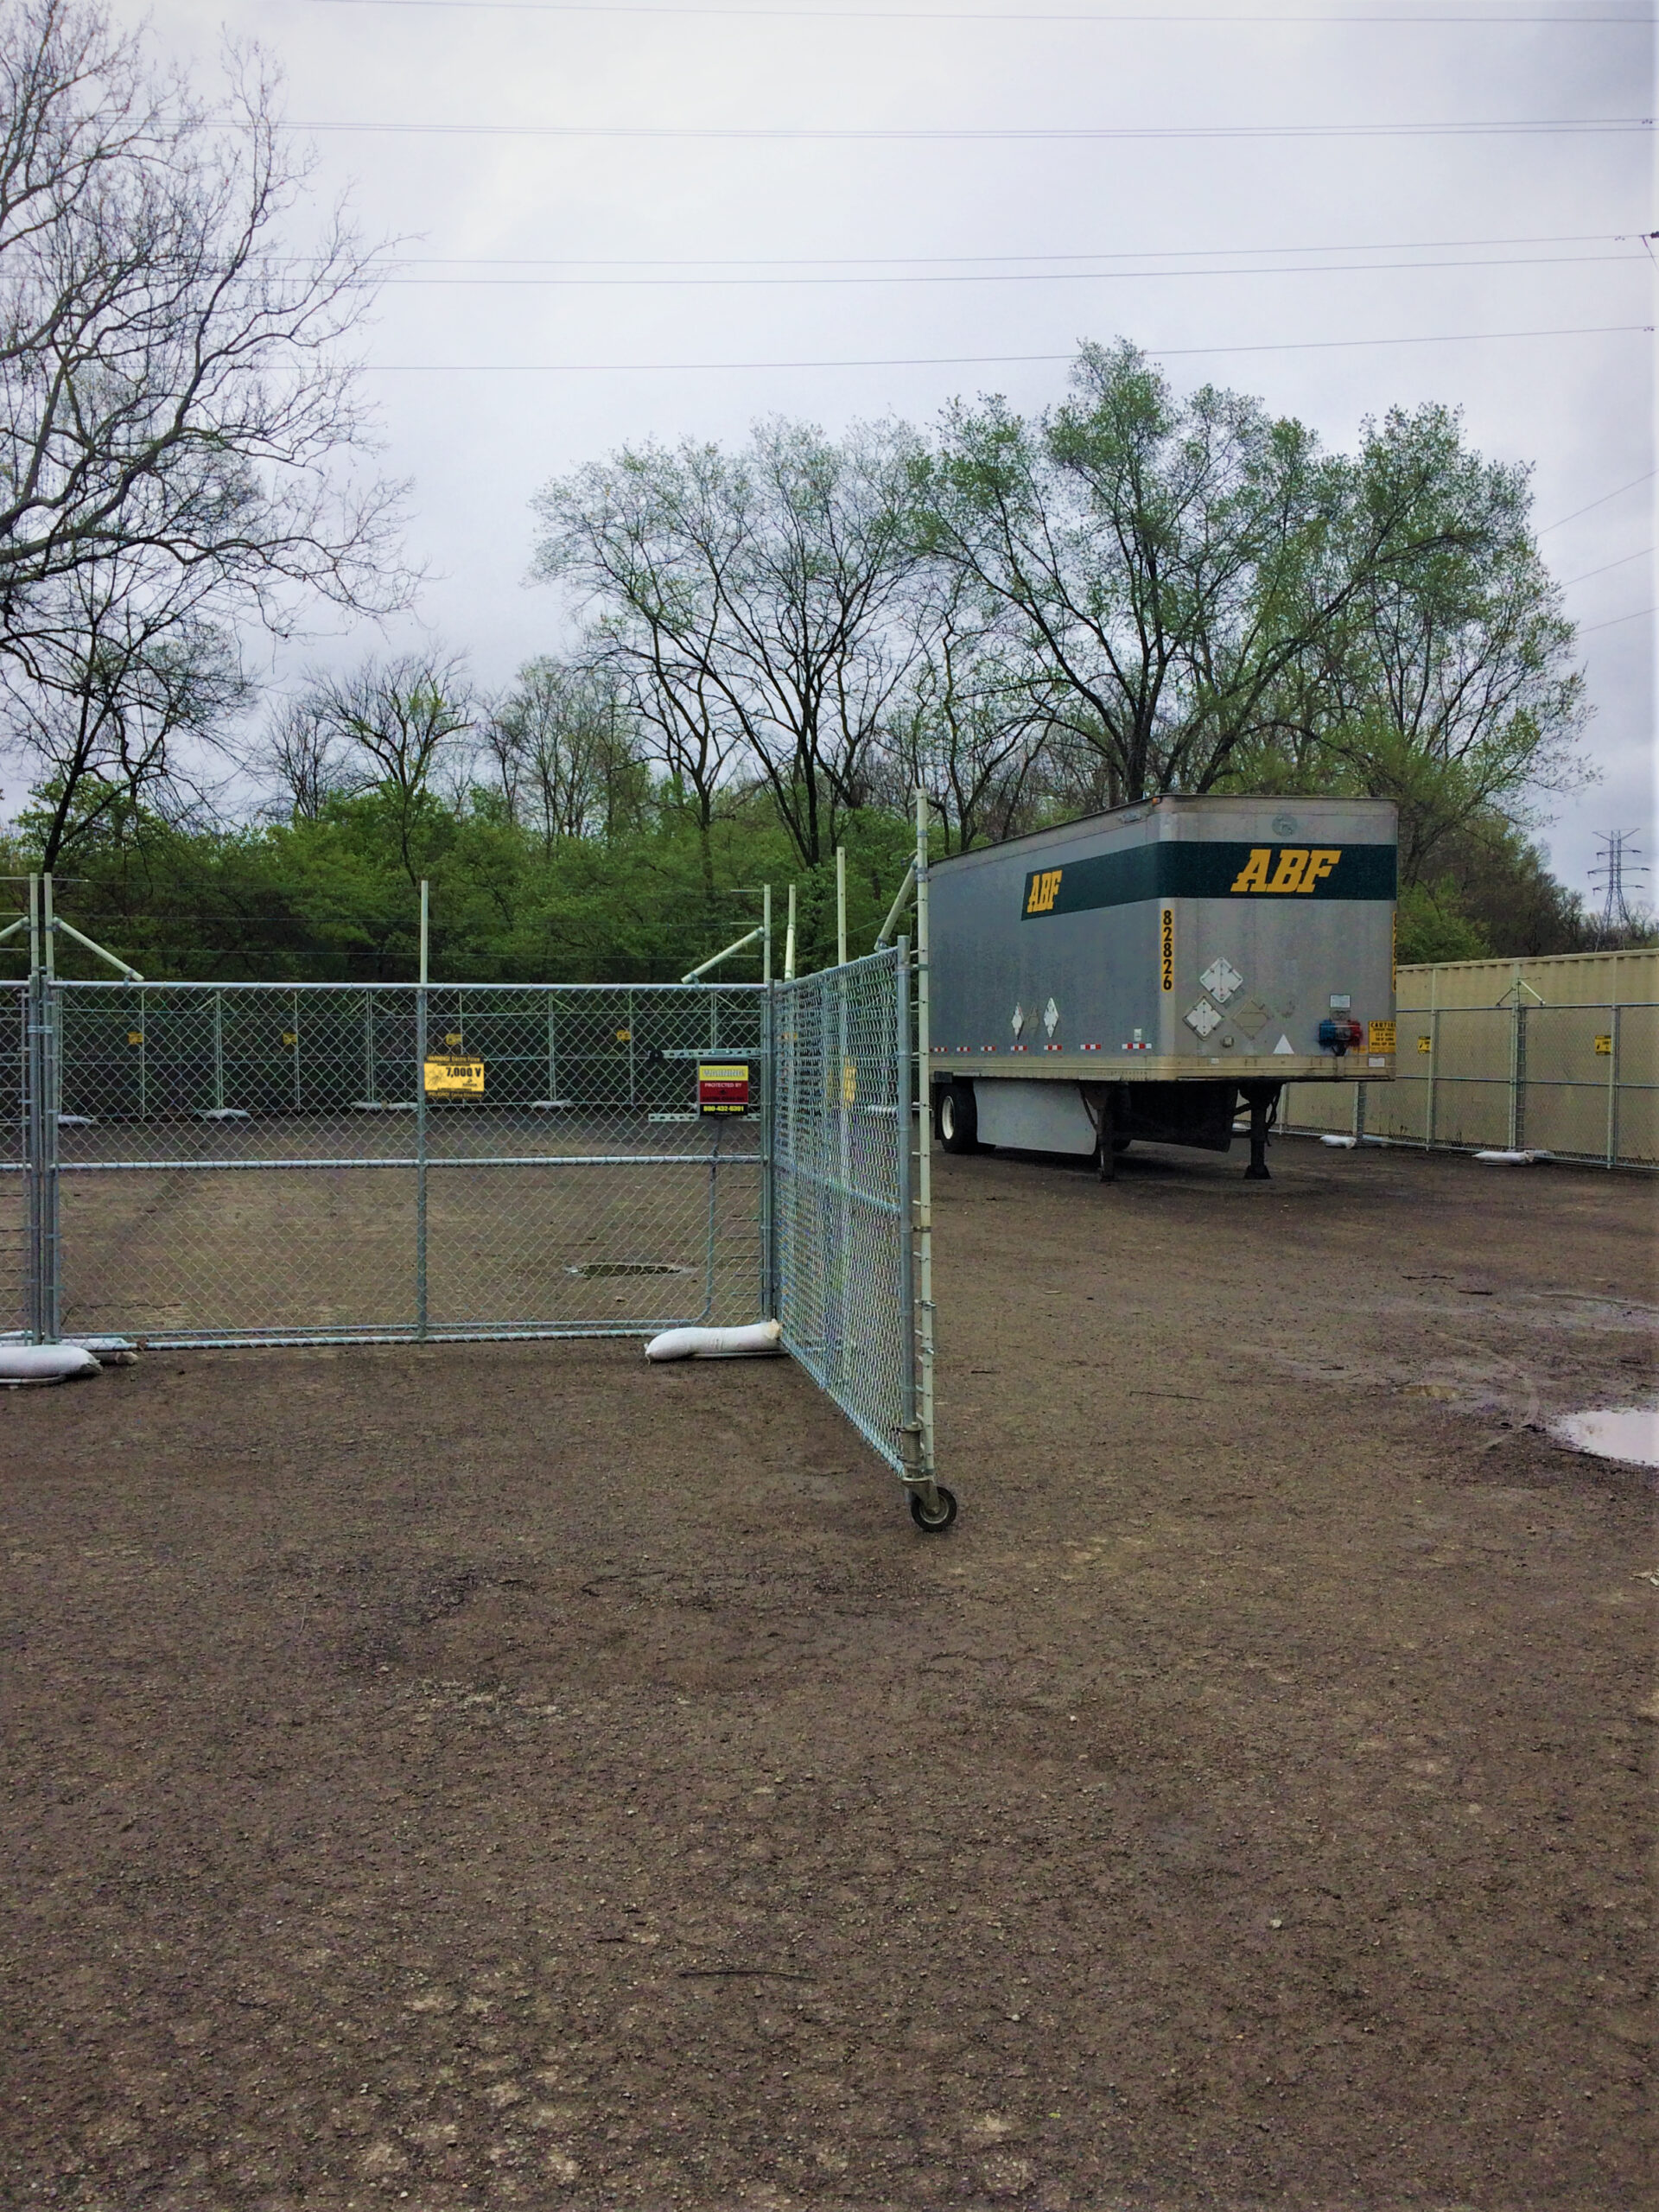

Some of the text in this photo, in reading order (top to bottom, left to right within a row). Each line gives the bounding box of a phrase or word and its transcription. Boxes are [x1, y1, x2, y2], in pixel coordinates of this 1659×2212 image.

[1027, 869, 1063, 913] ABF
[1230, 849, 1342, 893] ABF
[1163, 910, 1173, 990] 82826
[446, 1067, 481, 1078] 7,000 V
